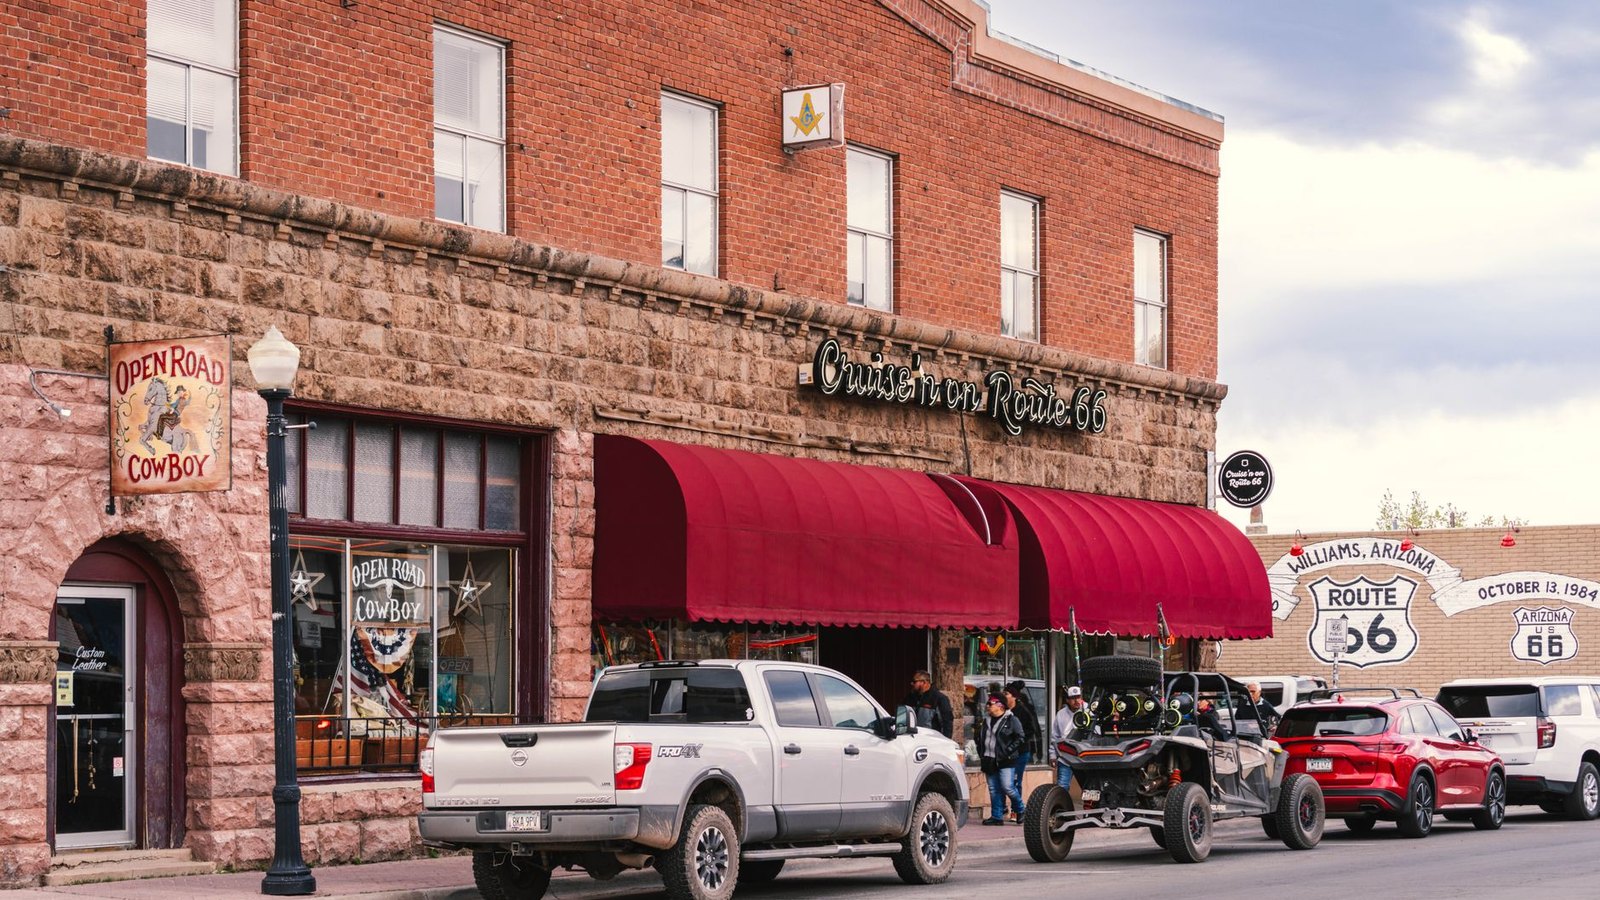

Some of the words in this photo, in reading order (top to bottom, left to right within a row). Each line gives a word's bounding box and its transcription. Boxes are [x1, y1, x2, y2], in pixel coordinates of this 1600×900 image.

[116, 351, 167, 395] OPEN
[170, 345, 225, 385] ROAD
[942, 377, 982, 412] on
[984, 370, 1069, 436] Route
[1071, 386, 1107, 433] 66
[128, 453, 210, 483] COWBOY
[1229, 478, 1251, 488] Route
[1251, 477, 1262, 485] 66
[1370, 541, 1436, 575] ARIZONA
[352, 558, 388, 587] OPEN
[392, 558, 426, 588] ROAD
[1328, 588, 1397, 606] ROUTE
[1478, 581, 1541, 600] OCTOBER
[1564, 583, 1598, 602] 1984
[356, 596, 421, 622] COWBOY
[1521, 611, 1568, 622] ARIZONA
[76, 645, 105, 658] Custom
[1527, 635, 1562, 657] 66
[72, 658, 107, 670] Leather
[440, 660, 470, 671] OPEN
